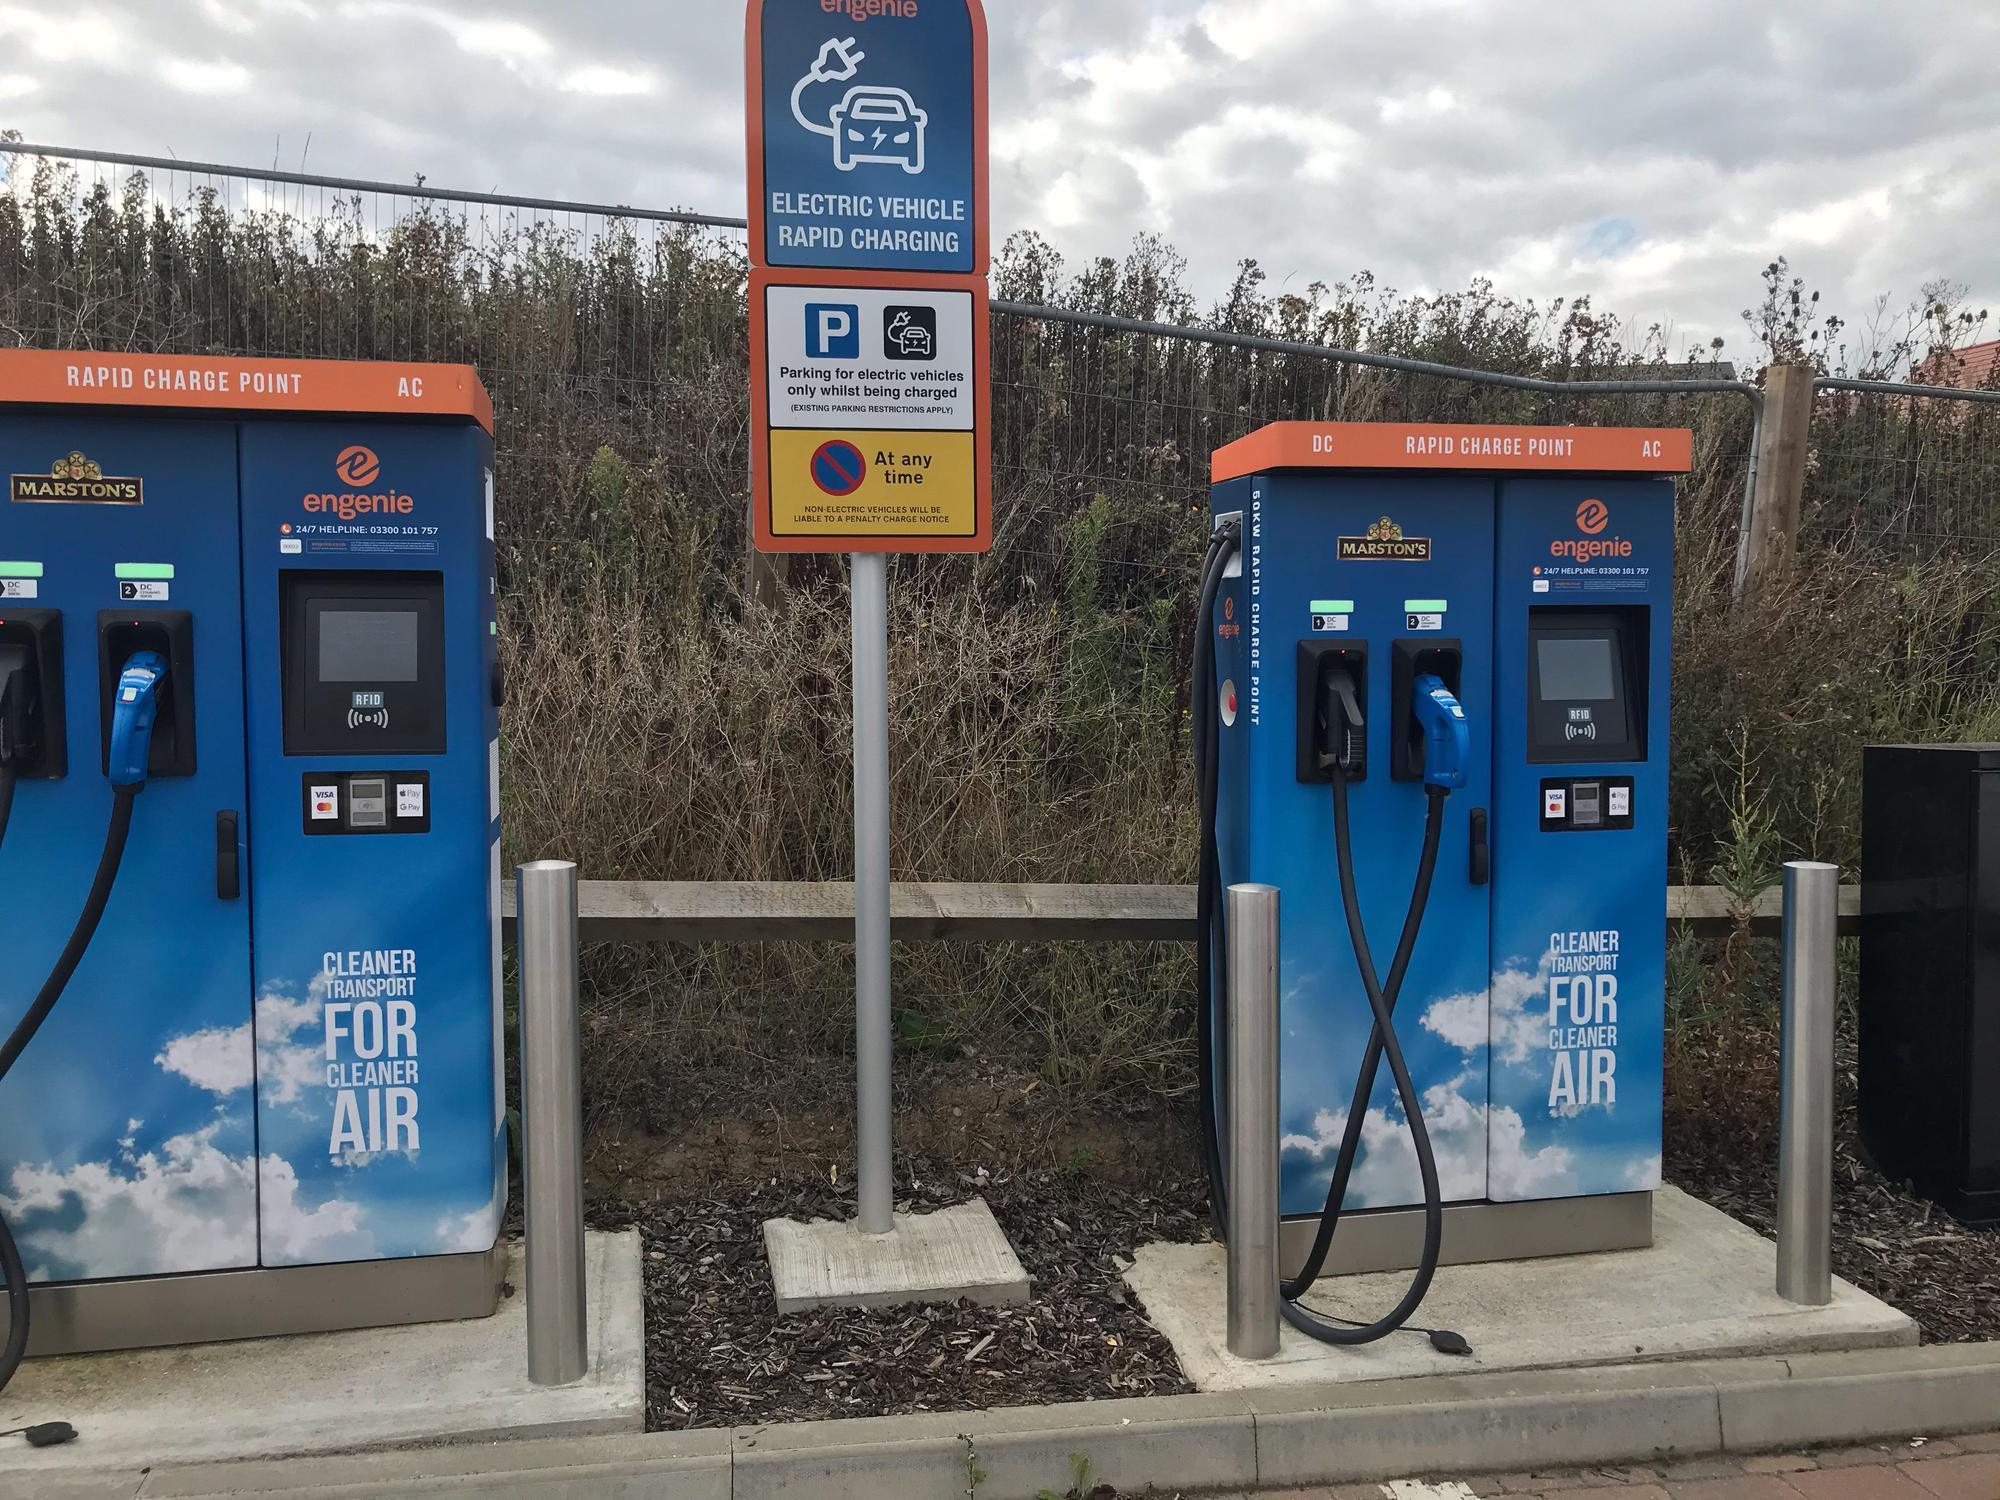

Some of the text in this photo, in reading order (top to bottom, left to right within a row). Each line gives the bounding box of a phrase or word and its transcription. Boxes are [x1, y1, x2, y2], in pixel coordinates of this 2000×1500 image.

[820, 0, 918, 21] engenie
[772, 192, 965, 221] ELECTRIC VEHICLE
[779, 225, 959, 252] RAPID CHARGING
[819, 310, 850, 352] P
[67, 366, 301, 394] RAPID CHARGE POINT
[780, 367, 964, 381] Parking for electric vehicles
[398, 377, 423, 397] AC
[788, 384, 957, 400] only whilst being charged
[791, 404, 830, 413] (EXISTING
[831, 405, 867, 413] PARKING
[869, 406, 925, 414] RESTRICTIONS
[1312, 434, 1333, 453] DC
[1406, 436, 1574, 456] RAPID CHARGE POINT
[1642, 440, 1661, 457] AC
[875, 451, 932, 469] At any
[885, 470, 923, 484] time
[19, 481, 136, 498] MARSTON'S
[303, 489, 414, 521] engenie
[867, 506, 907, 514] VEHICLES
[909, 506, 928, 514] WILL
[931, 506, 941, 514] BE
[296, 525, 316, 534] 24/7
[319, 526, 368, 534] HELPLINE:
[370, 526, 399, 534] 03300
[421, 527, 439, 535] 757
[1342, 542, 1426, 555] MARSTON'S
[1551, 536, 1632, 563] engenie
[1543, 567, 1649, 575] 24/7 HELPLINE: 03300 101 757
[125, 586, 131, 595] 2
[1251, 490, 1260, 726] 50KW RAPID CHARGE POINT
[355, 694, 381, 706] RFID
[1570, 709, 1590, 720] RFID
[315, 791, 335, 799] VISA
[408, 803, 421, 811] Pay
[1550, 930, 1619, 953] CLEANER
[323, 949, 416, 977] CLEANER
[1551, 954, 1619, 973] TRANSPORT
[324, 977, 416, 999] TRANSPORT
[1549, 974, 1618, 1026] FOR
[324, 1000, 418, 1061] FOR
[1549, 1025, 1617, 1050] CLEANER
[326, 1060, 419, 1088] CLEANER
[1548, 1049, 1617, 1107] AIR
[328, 1086, 420, 1155] AIR
